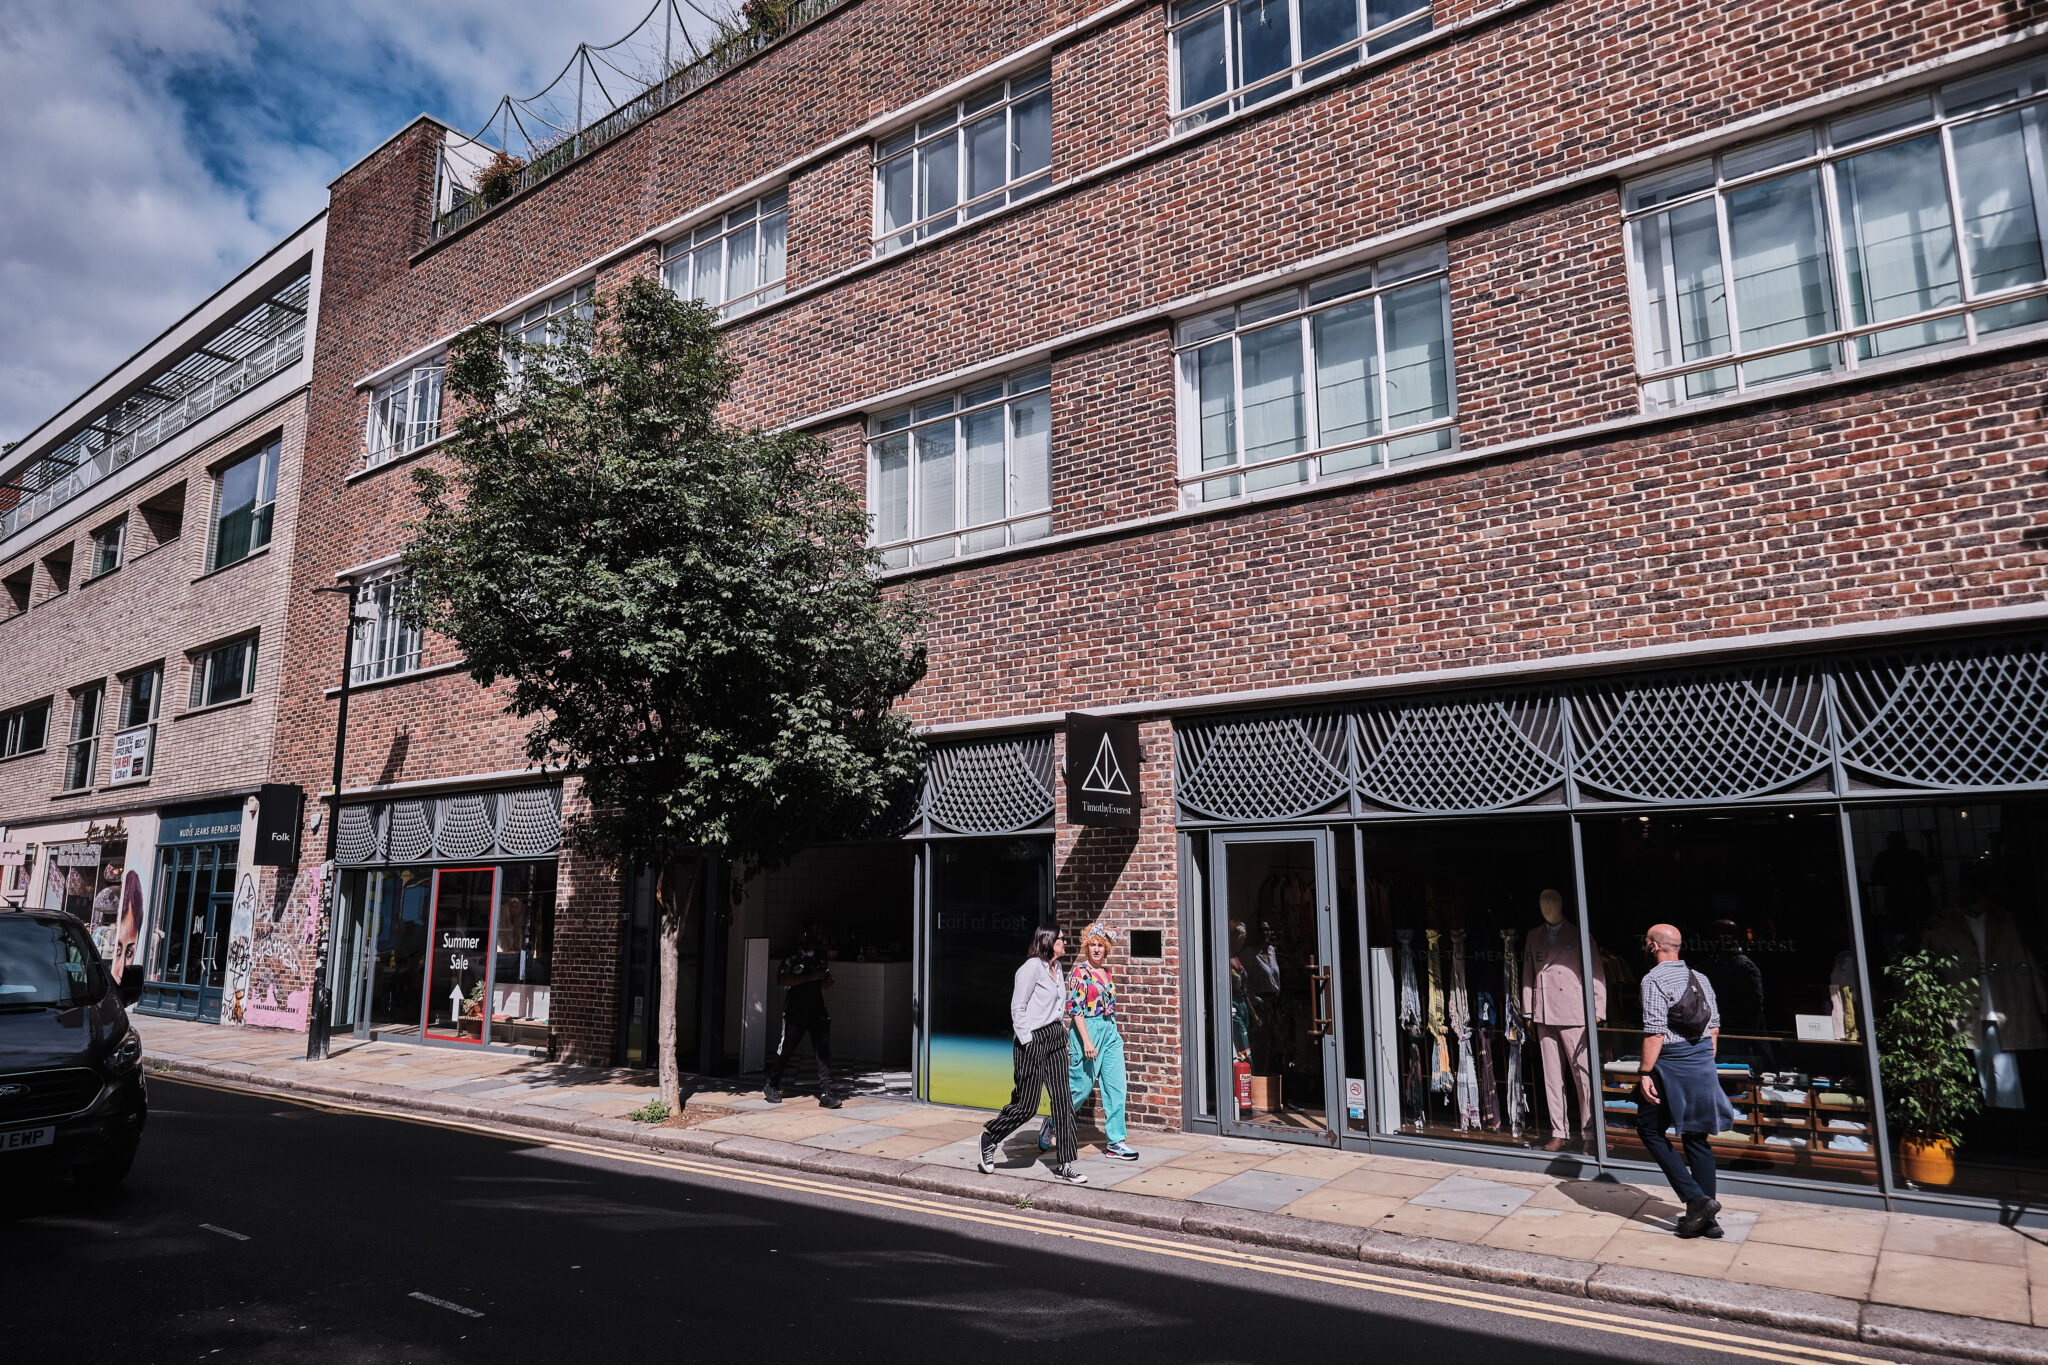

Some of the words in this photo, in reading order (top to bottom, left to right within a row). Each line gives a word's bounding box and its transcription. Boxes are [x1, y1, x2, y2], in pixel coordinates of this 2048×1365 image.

[121, 755, 132, 768] RENT
[1081, 800, 1132, 817] TimothyEverest
[179, 828, 194, 837] NUDIE
[194, 826, 210, 836] JEANS
[211, 824, 229, 835] REPAIR
[229, 823, 242, 833] SHO
[271, 832, 291, 842] Folk
[2, 849, 25, 859] people
[937, 911, 967, 929] Earl
[971, 911, 988, 929] of
[992, 911, 1027, 930] East
[442, 932, 480, 949] Summer
[449, 953, 469, 970] Sale
[9, 1130, 44, 1147] EWP
